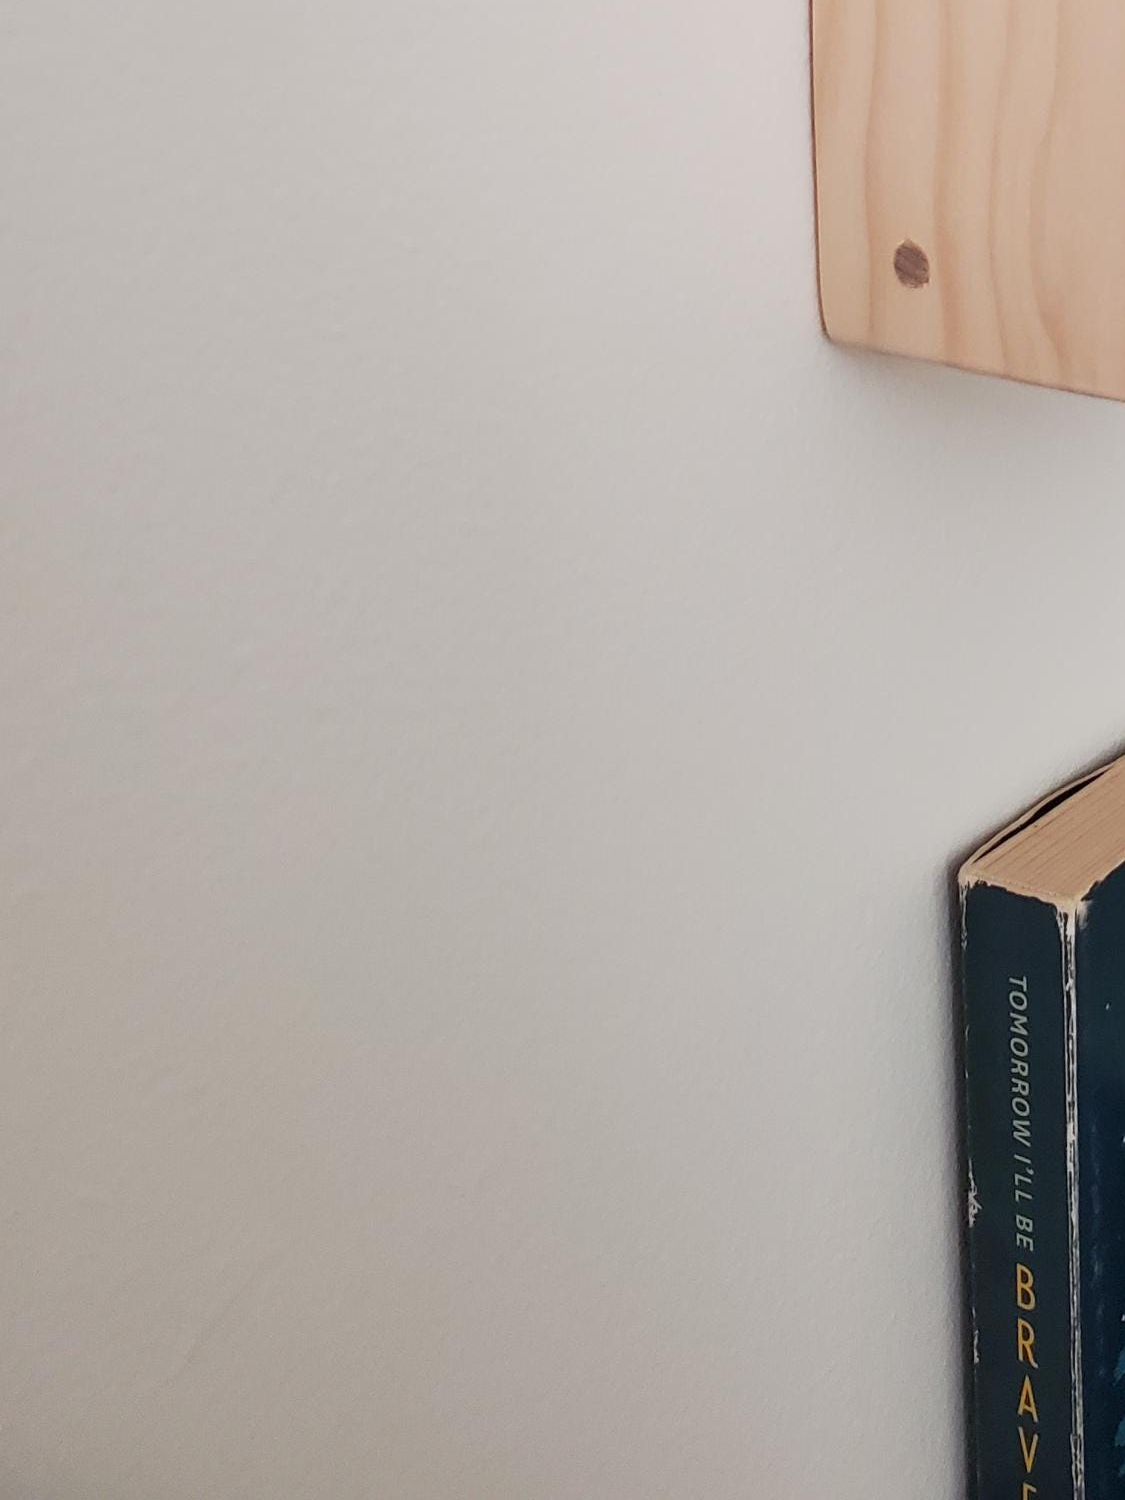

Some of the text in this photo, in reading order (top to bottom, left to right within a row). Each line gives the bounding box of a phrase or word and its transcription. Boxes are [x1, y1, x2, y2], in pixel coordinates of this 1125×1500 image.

[1006, 975, 1034, 1252] TOMORROW I'LL BE
